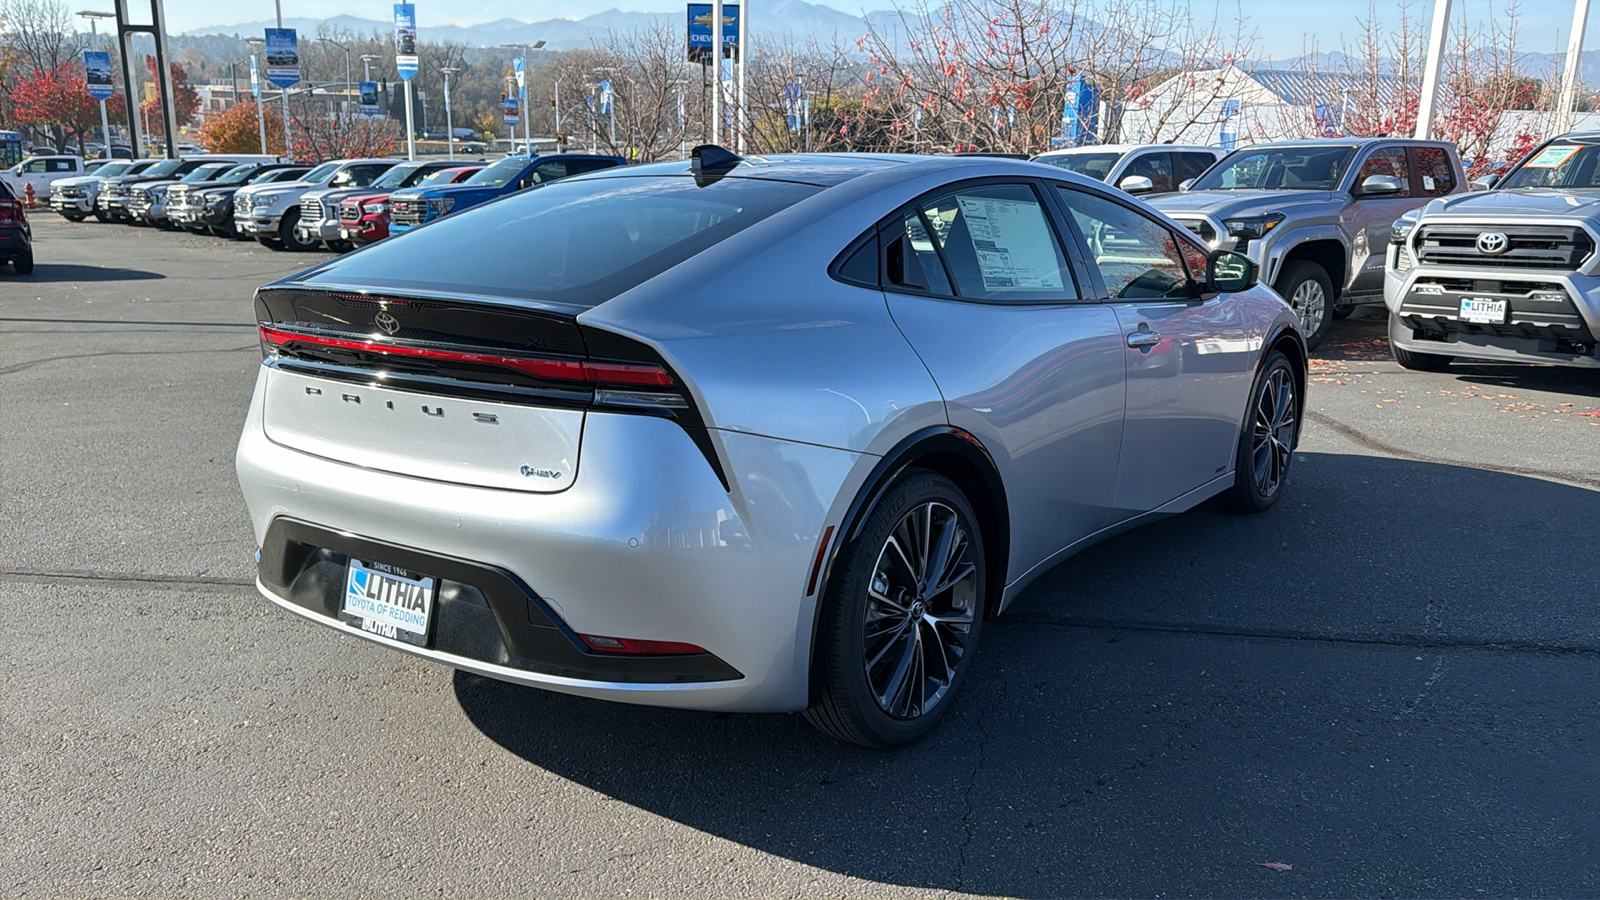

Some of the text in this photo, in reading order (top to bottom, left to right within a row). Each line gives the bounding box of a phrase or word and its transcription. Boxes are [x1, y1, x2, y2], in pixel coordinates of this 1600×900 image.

[690, 34, 736, 42] CHEVLET
[1471, 302, 1503, 312] LITHIA
[526, 336, 569, 350] XLE
[305, 386, 500, 425] PRIUS
[373, 561, 408, 577] SINCE 1946
[366, 573, 426, 614] LITHIA
[348, 595, 426, 627] TOYOTA OF REDDING
[370, 620, 398, 640] LITHIA
